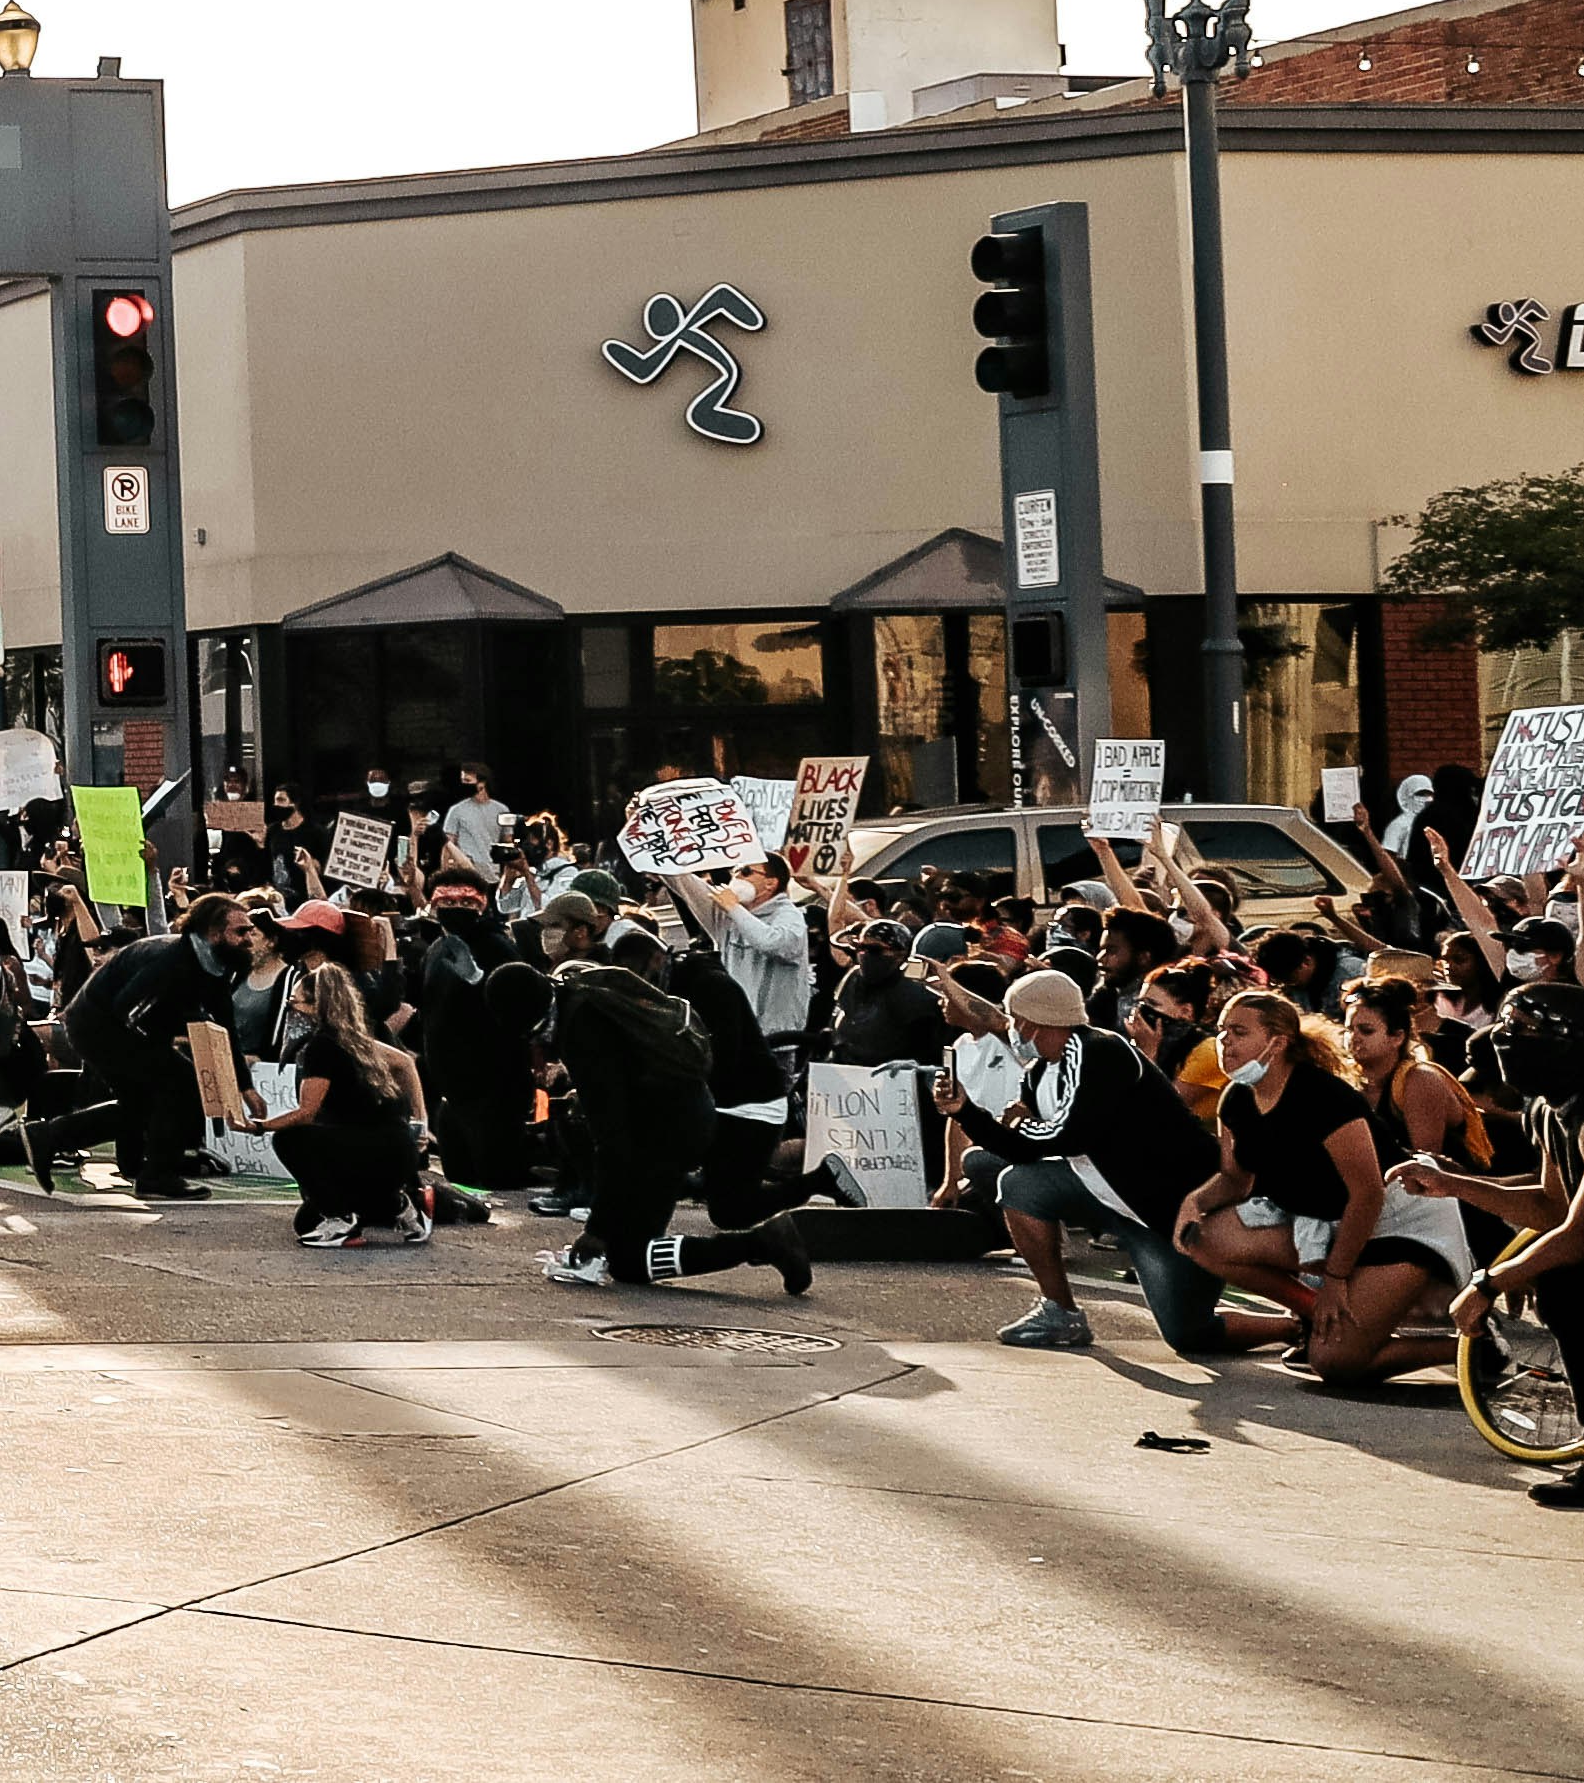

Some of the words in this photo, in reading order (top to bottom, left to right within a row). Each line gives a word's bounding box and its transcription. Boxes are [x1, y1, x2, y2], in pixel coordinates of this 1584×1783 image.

[116, 505, 137, 515] BIKE
[114, 517, 140, 528] LANE
[1104, 745, 1127, 768] BAD
[1131, 745, 1161, 768] APPLE
[799, 764, 863, 794] BLACK
[799, 797, 850, 820] LIVES
[827, 1128, 889, 1152] LIVES
